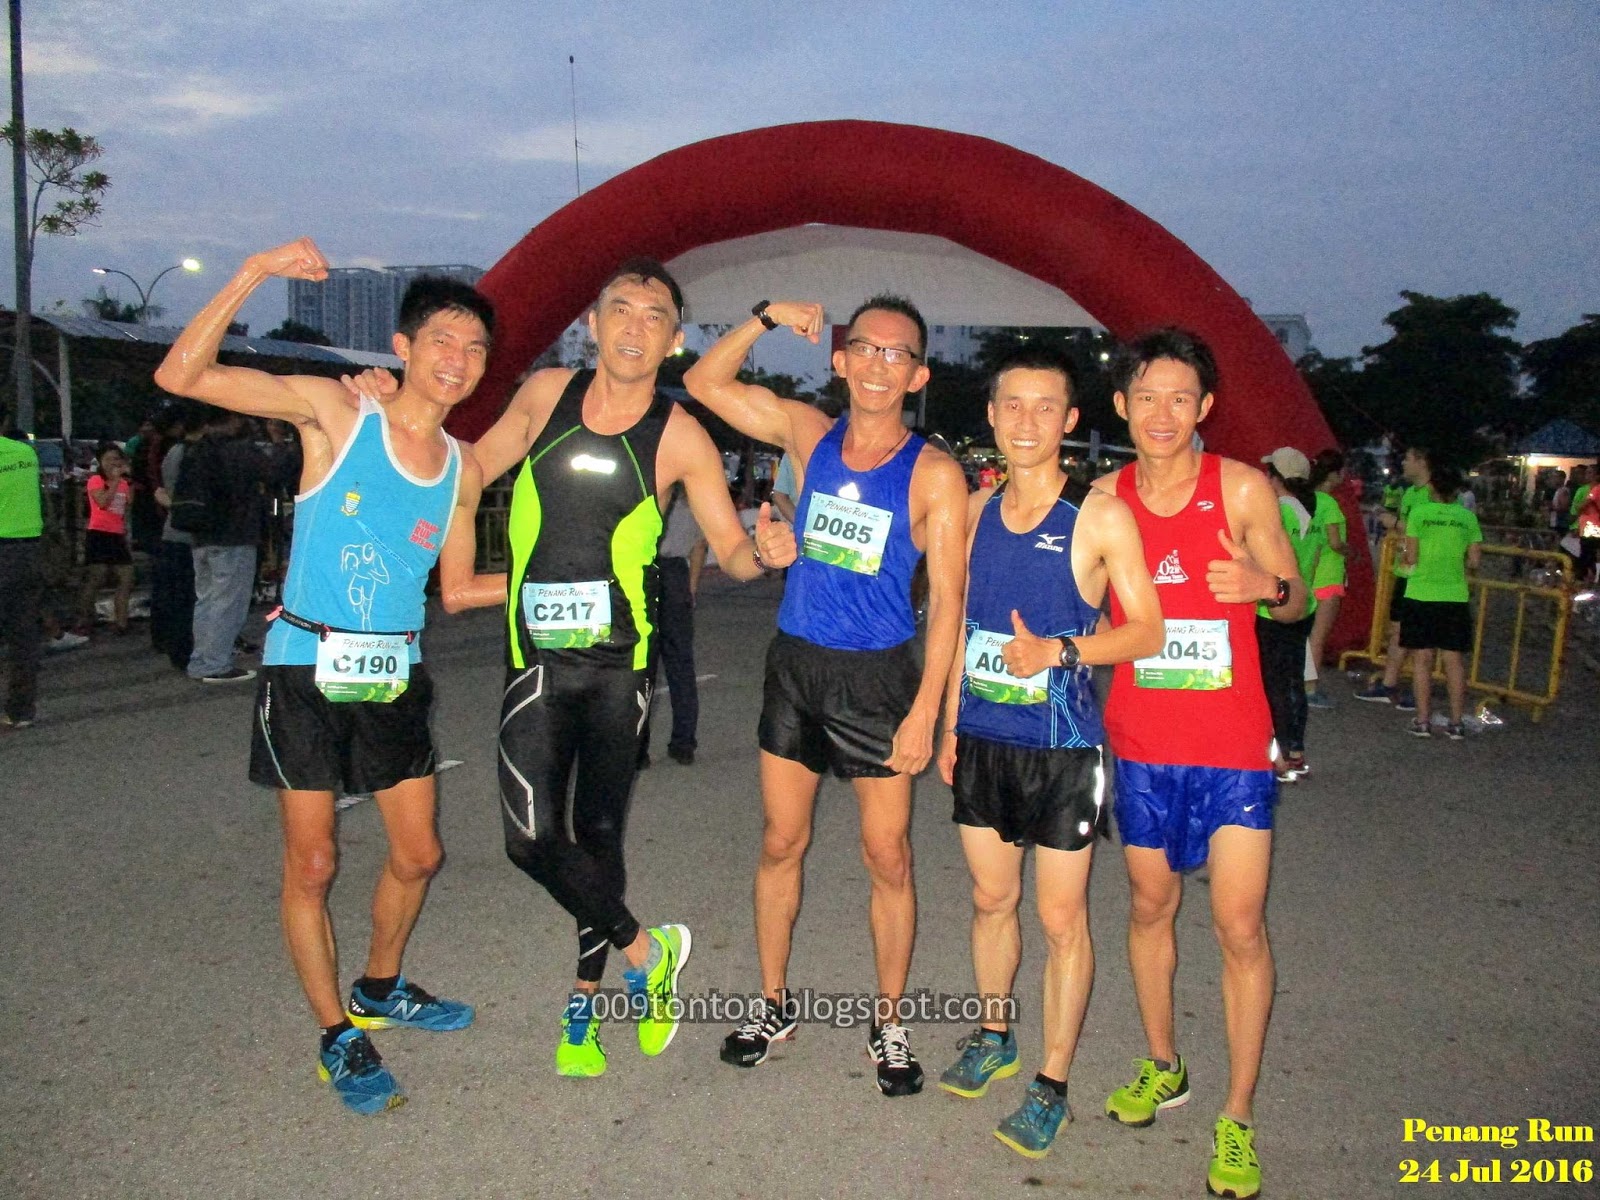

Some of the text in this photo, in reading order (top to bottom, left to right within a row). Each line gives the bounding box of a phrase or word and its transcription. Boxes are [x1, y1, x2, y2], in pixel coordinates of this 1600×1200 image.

[824, 501, 852, 515] PENANG
[852, 507, 869, 518] RUN
[813, 514, 873, 544] D085
[538, 588, 567, 597] PENANG
[569, 587, 584, 597] RUN
[534, 602, 595, 621] C217
[1166, 626, 1186, 634] NANG
[1188, 625, 1206, 634] RUN
[343, 639, 374, 649] PENANG
[376, 640, 391, 649] RUN
[333, 655, 398, 674] C190
